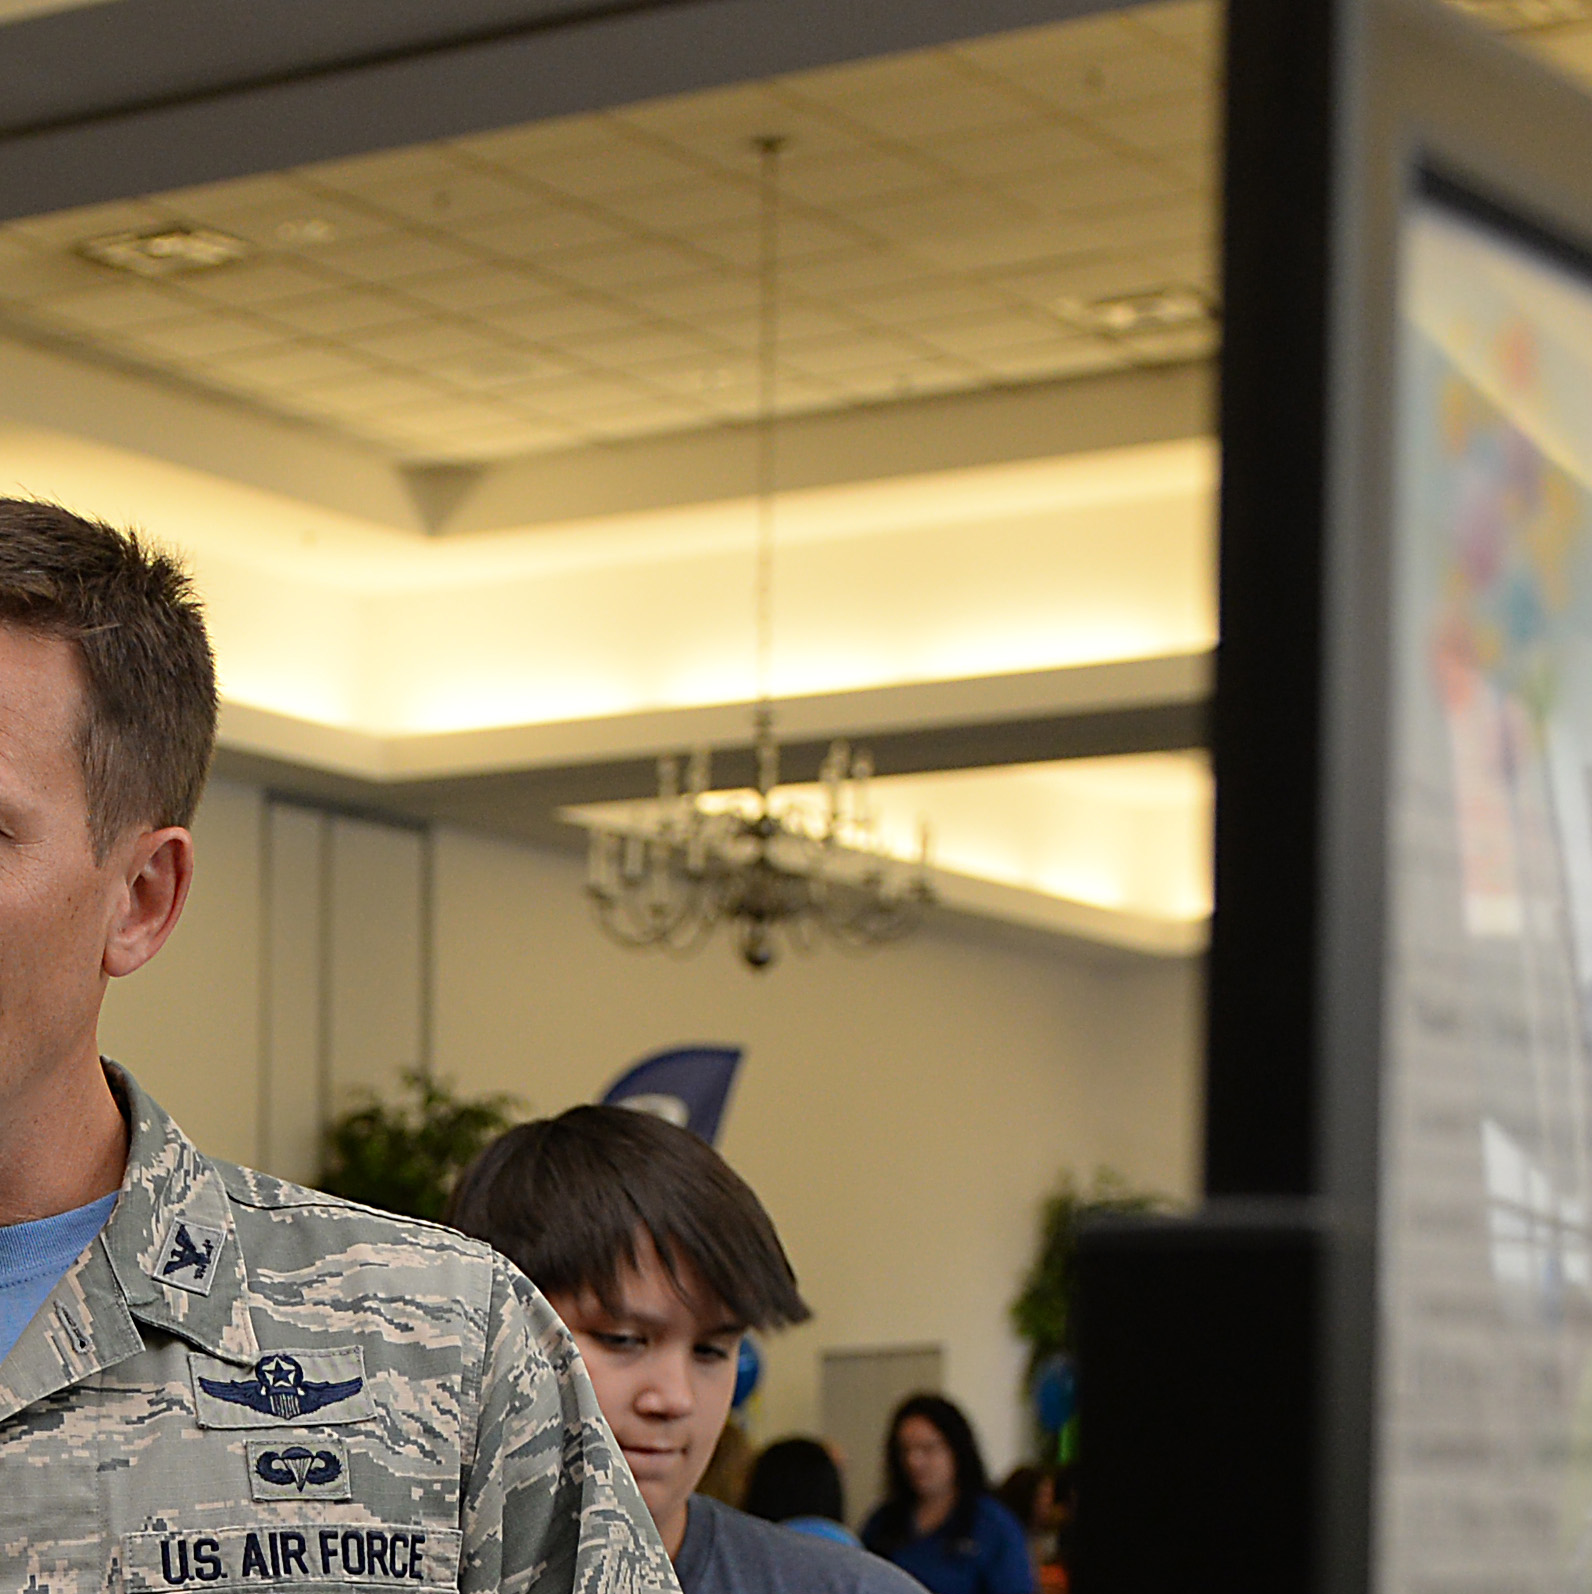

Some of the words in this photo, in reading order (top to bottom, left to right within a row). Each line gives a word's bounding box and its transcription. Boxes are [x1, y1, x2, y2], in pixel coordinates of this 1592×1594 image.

[160, 1538, 229, 1585] U.S.
[241, 1531, 310, 1579] AIR
[318, 1530, 427, 1580] FORCE
